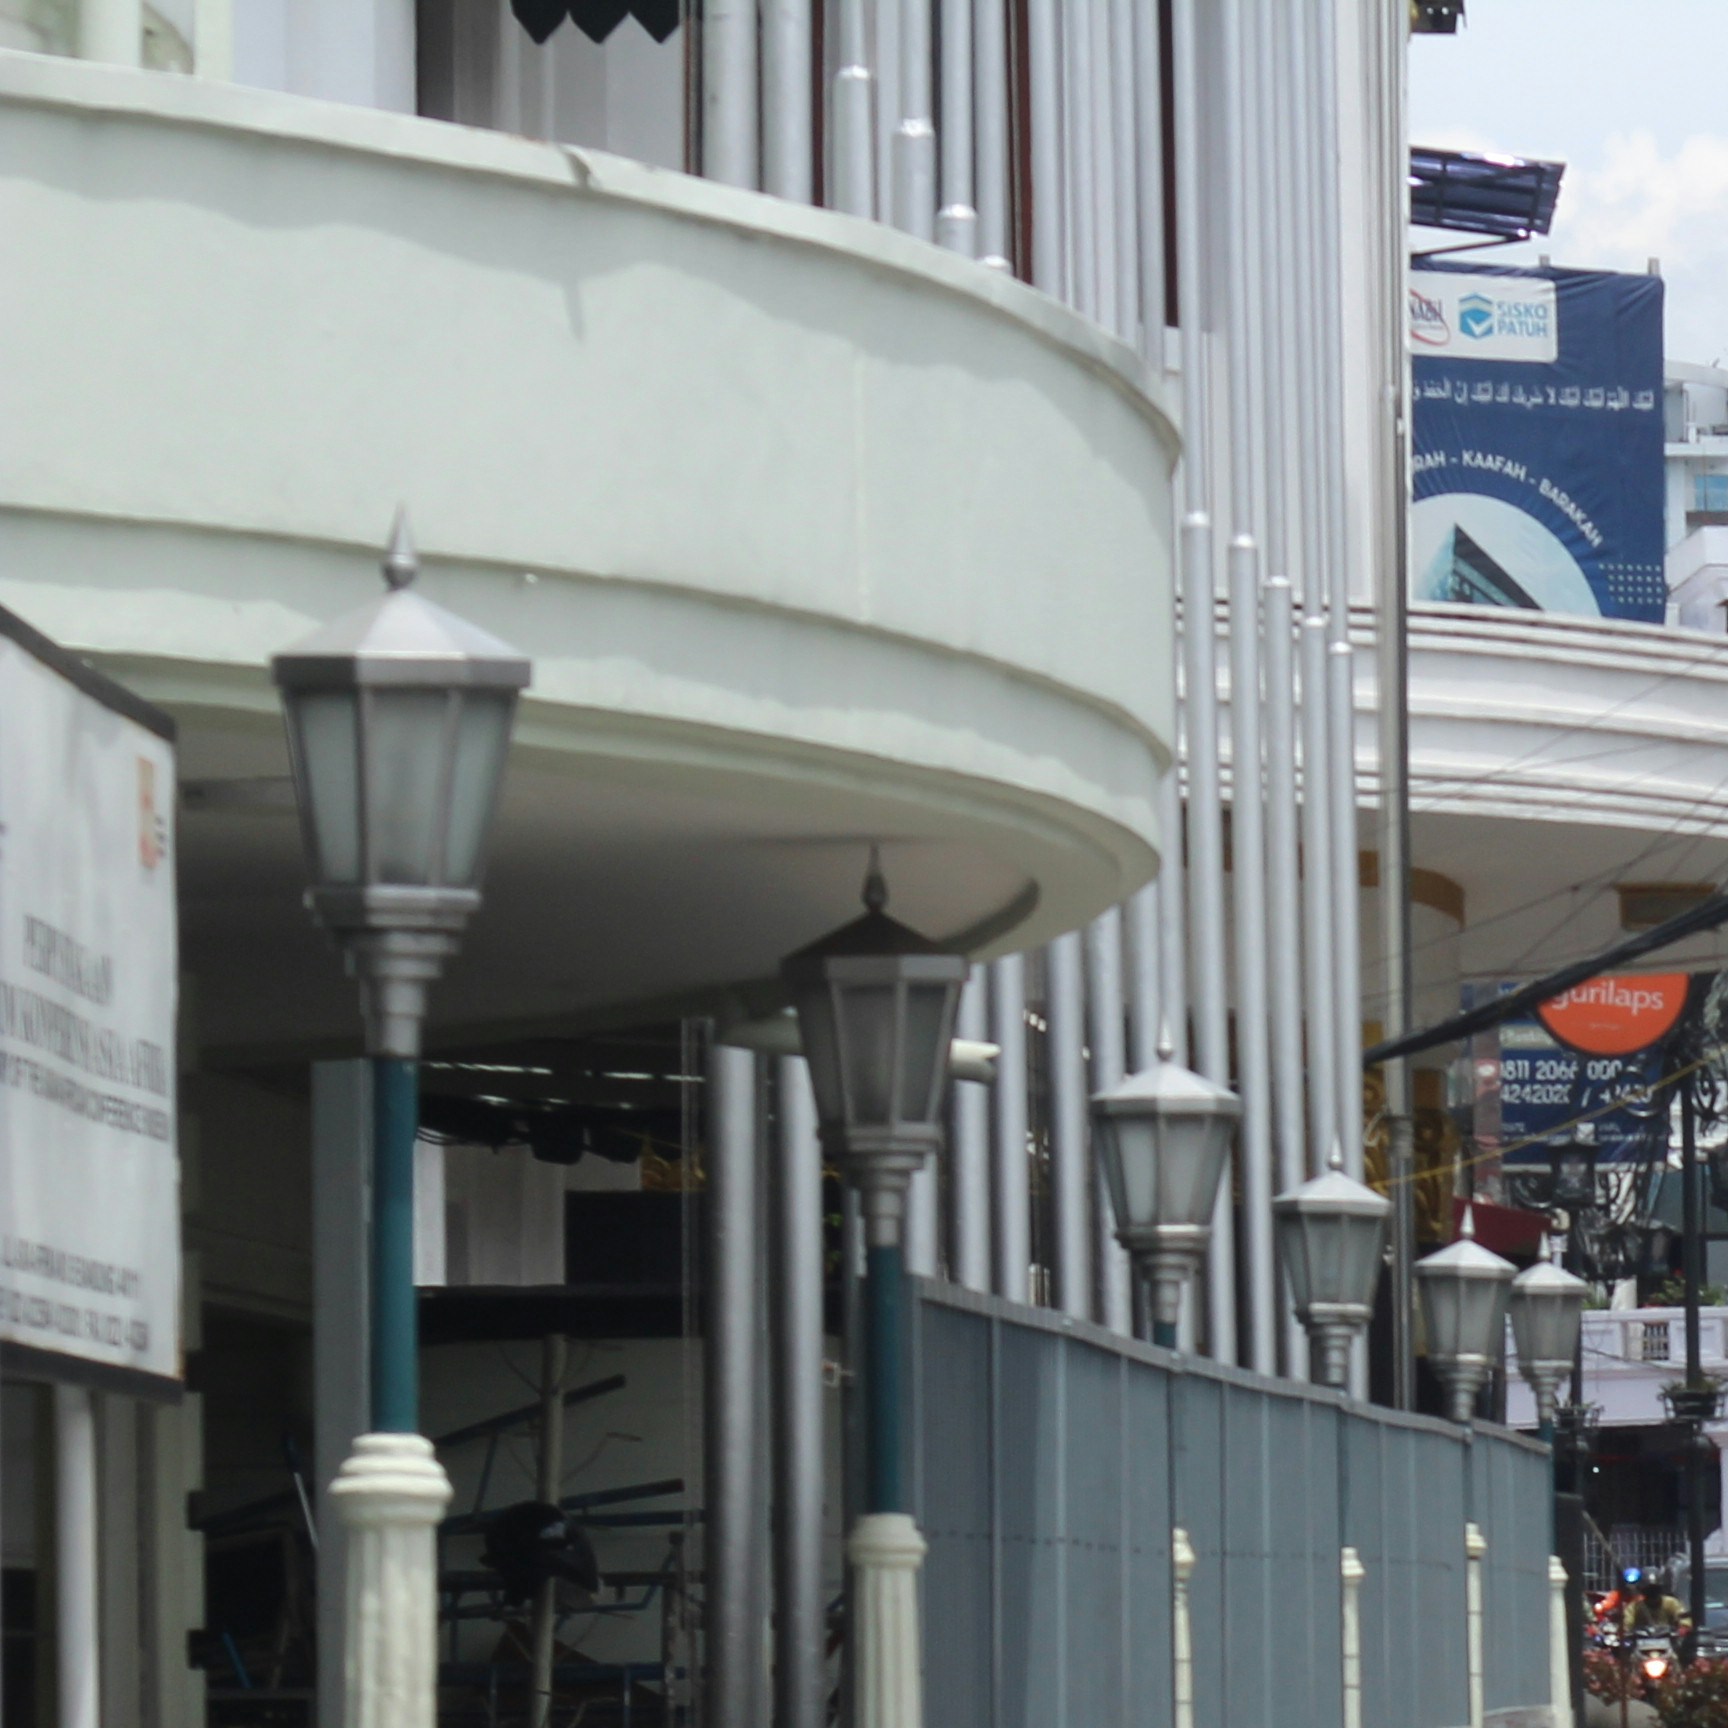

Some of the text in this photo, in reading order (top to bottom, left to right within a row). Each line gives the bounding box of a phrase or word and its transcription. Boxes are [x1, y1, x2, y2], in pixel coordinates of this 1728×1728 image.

[1496, 318, 1548, 337] PATUH
[1462, 450, 1527, 483] KAAFAH
[1539, 478, 1604, 548] BARAKAH
